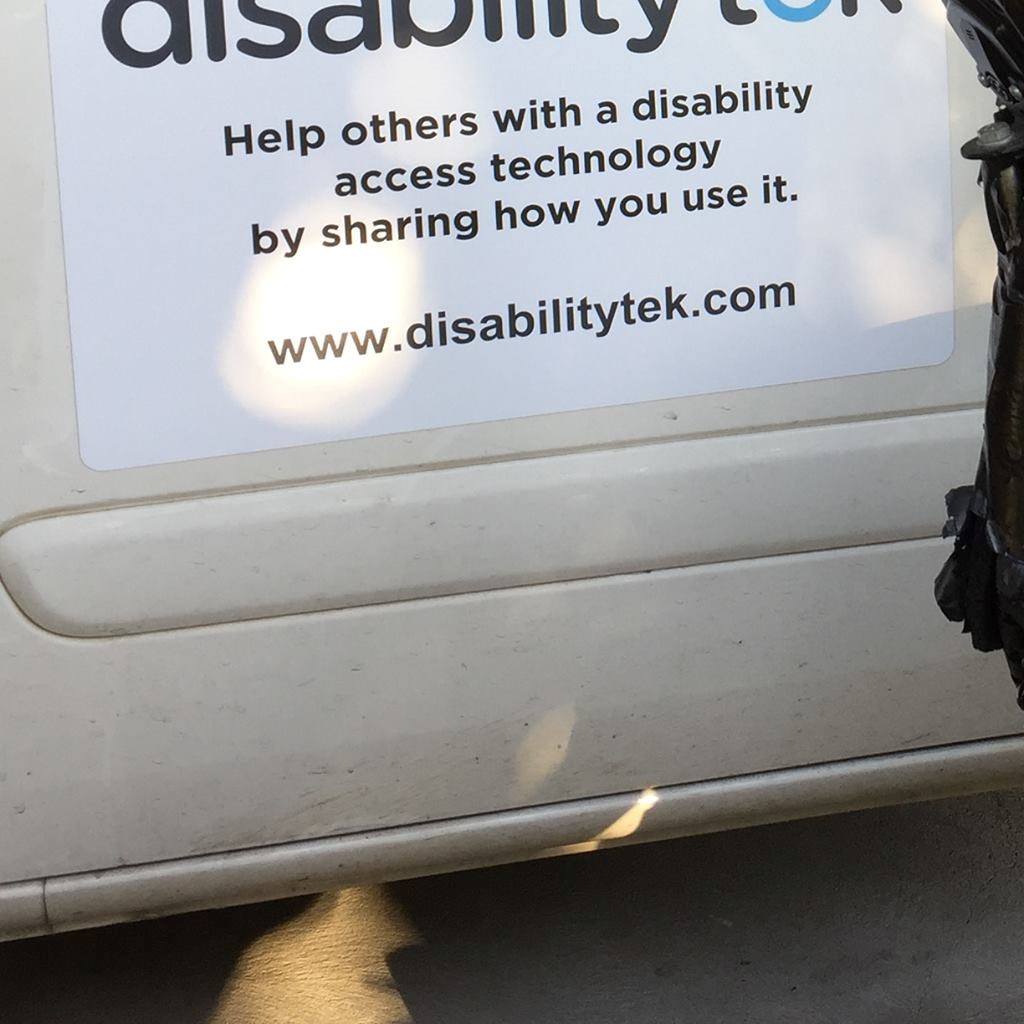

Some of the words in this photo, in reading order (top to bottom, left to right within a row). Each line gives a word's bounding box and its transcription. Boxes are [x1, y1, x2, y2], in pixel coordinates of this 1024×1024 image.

[224, 119, 325, 157] Help
[342, 111, 478, 145] others
[493, 97, 581, 132] with
[597, 101, 617, 125] a
[633, 81, 812, 121] disability
[335, 162, 476, 196] access
[490, 139, 721, 182] technology
[252, 224, 304, 258] by
[323, 208, 478, 246] sharing
[495, 200, 580, 230] how
[595, 192, 667, 226] you
[683, 185, 748, 211] use
[763, 175, 798, 207] it.
[268, 282, 795, 365] www.disabilitytek.com
